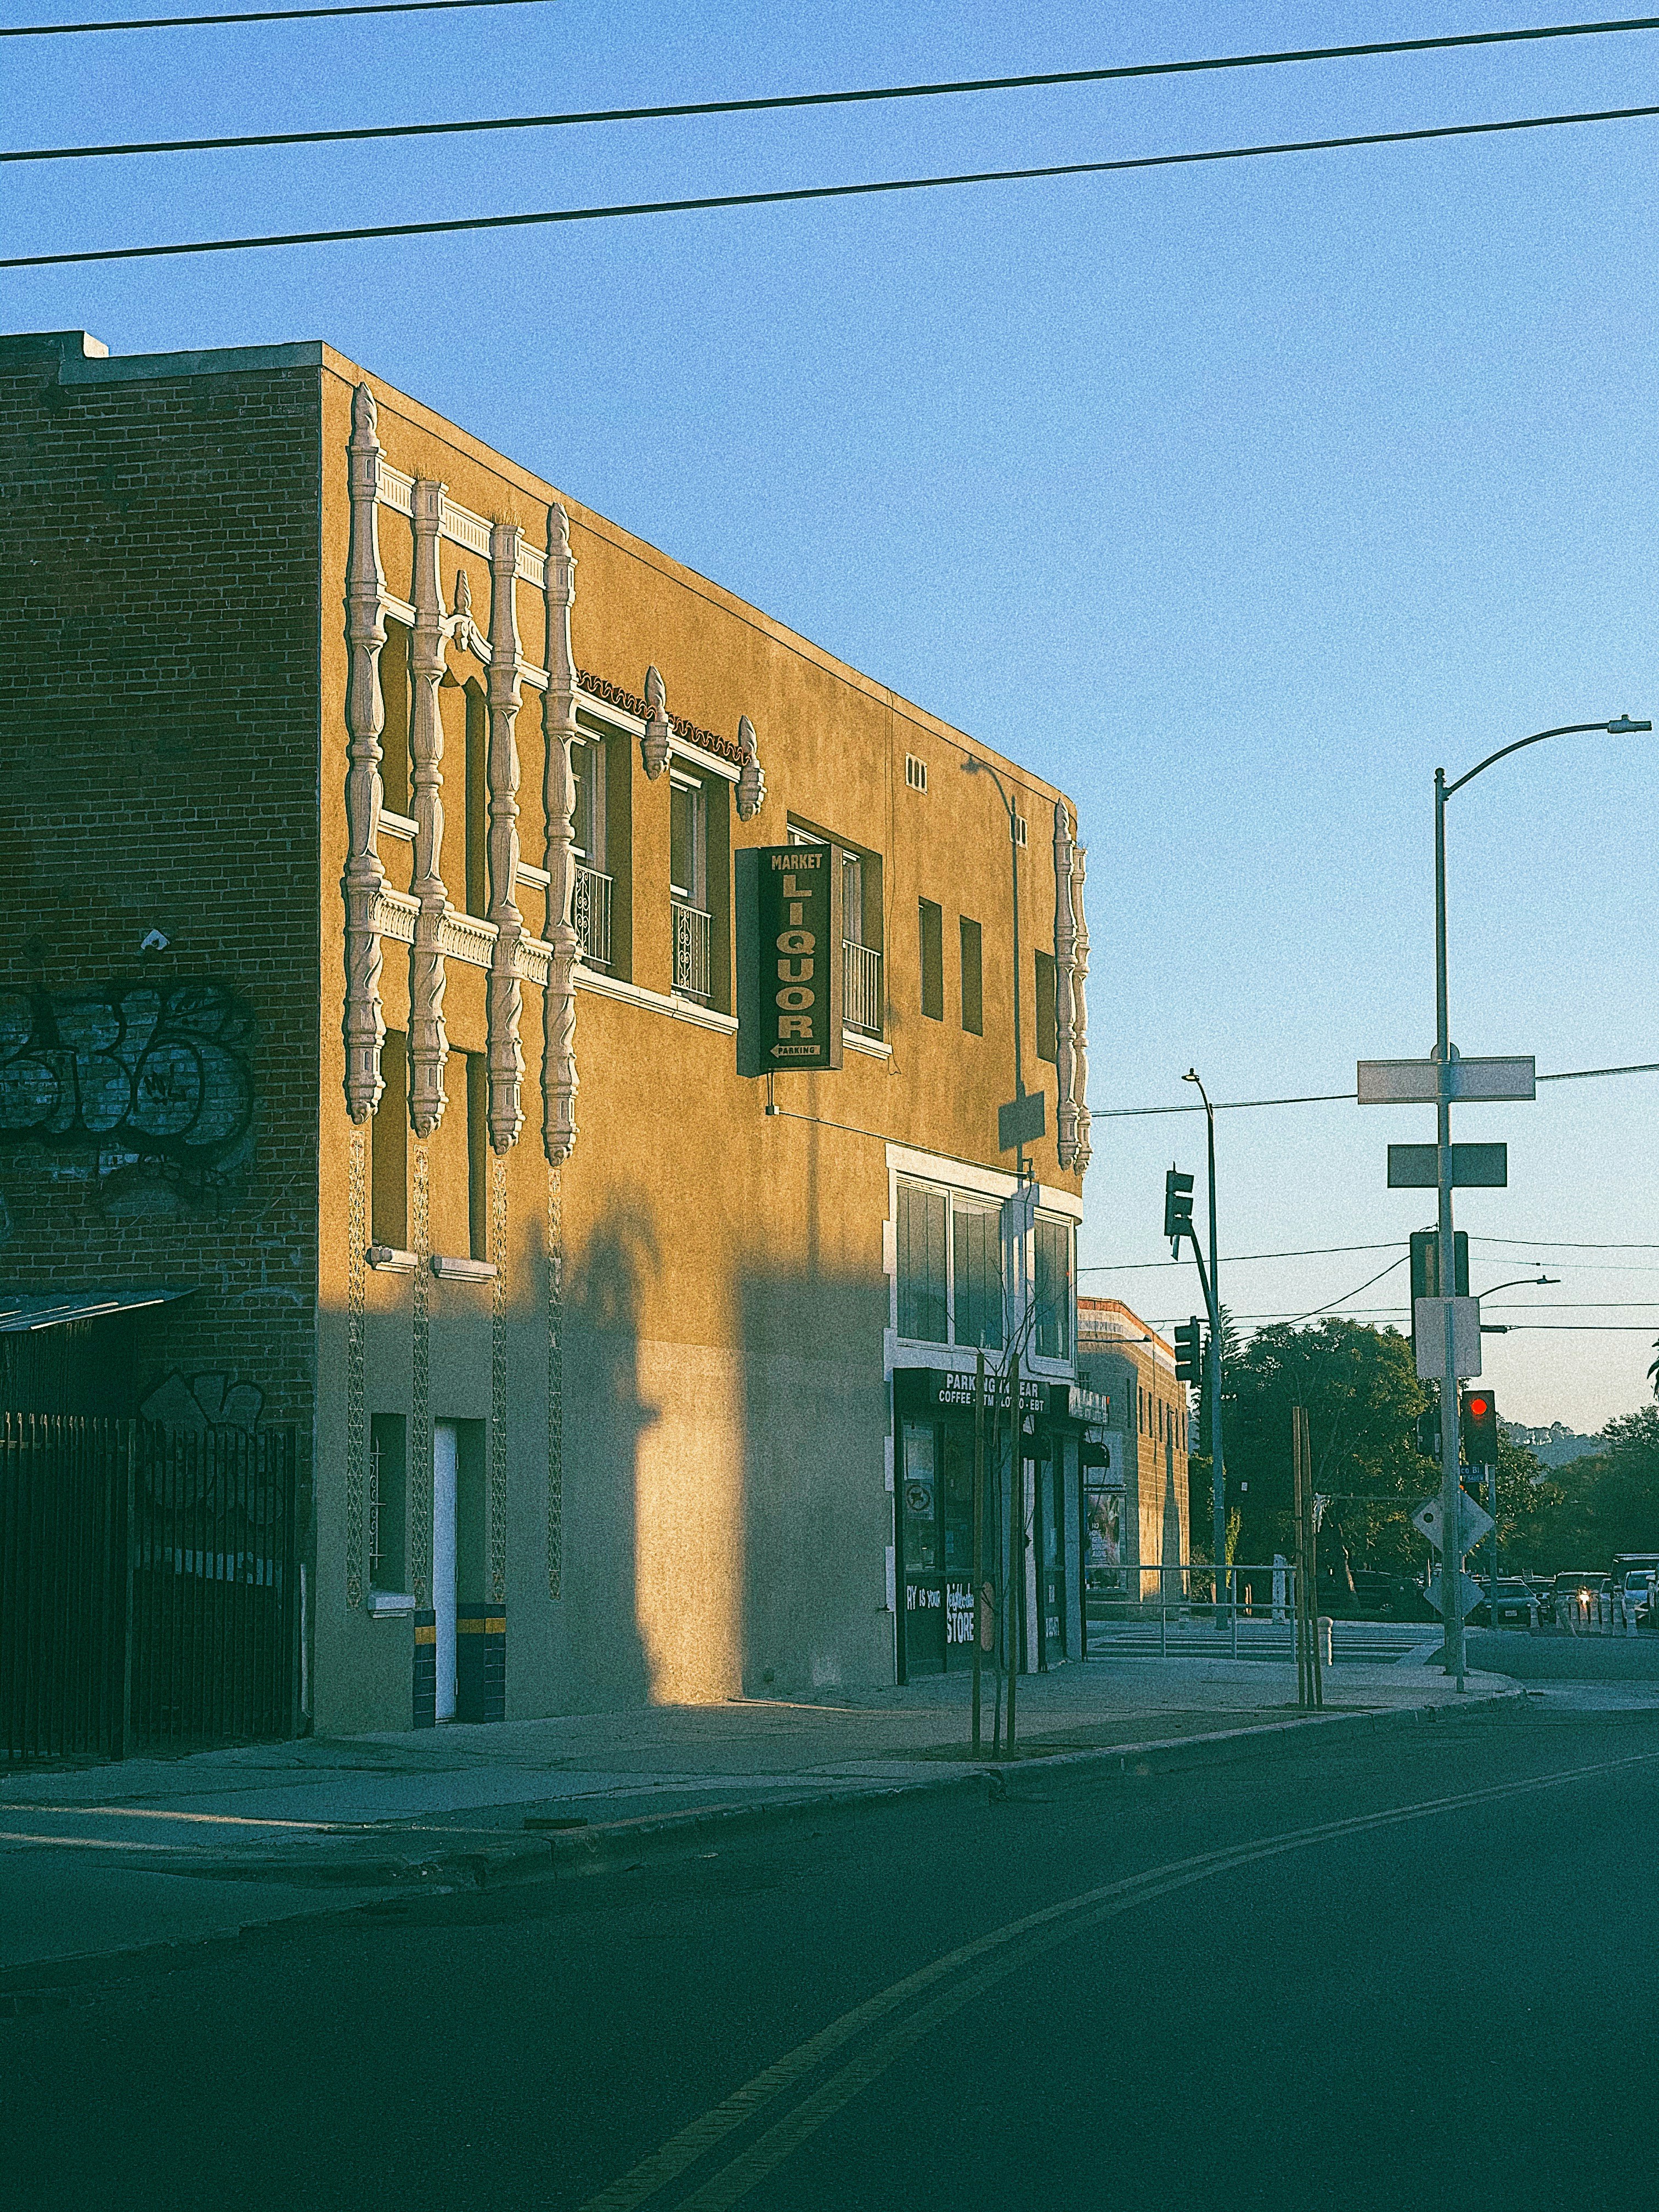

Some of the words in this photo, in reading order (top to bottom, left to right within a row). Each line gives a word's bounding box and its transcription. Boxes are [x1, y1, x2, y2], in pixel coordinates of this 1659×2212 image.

[771, 854, 822, 870] MARKET
[775, 874, 816, 1039] LIQUOR
[946, 1373, 996, 1393] PARKNG
[1019, 1381, 1039, 1398] EAR
[939, 1390, 971, 1404] COFFEE
[983, 1394, 994, 1407] TM
[1030, 1399, 1045, 1412] EBT
[919, 1588, 926, 1607] IS
[927, 1589, 941, 1609] YOUR
[946, 1612, 974, 1644] STORE
